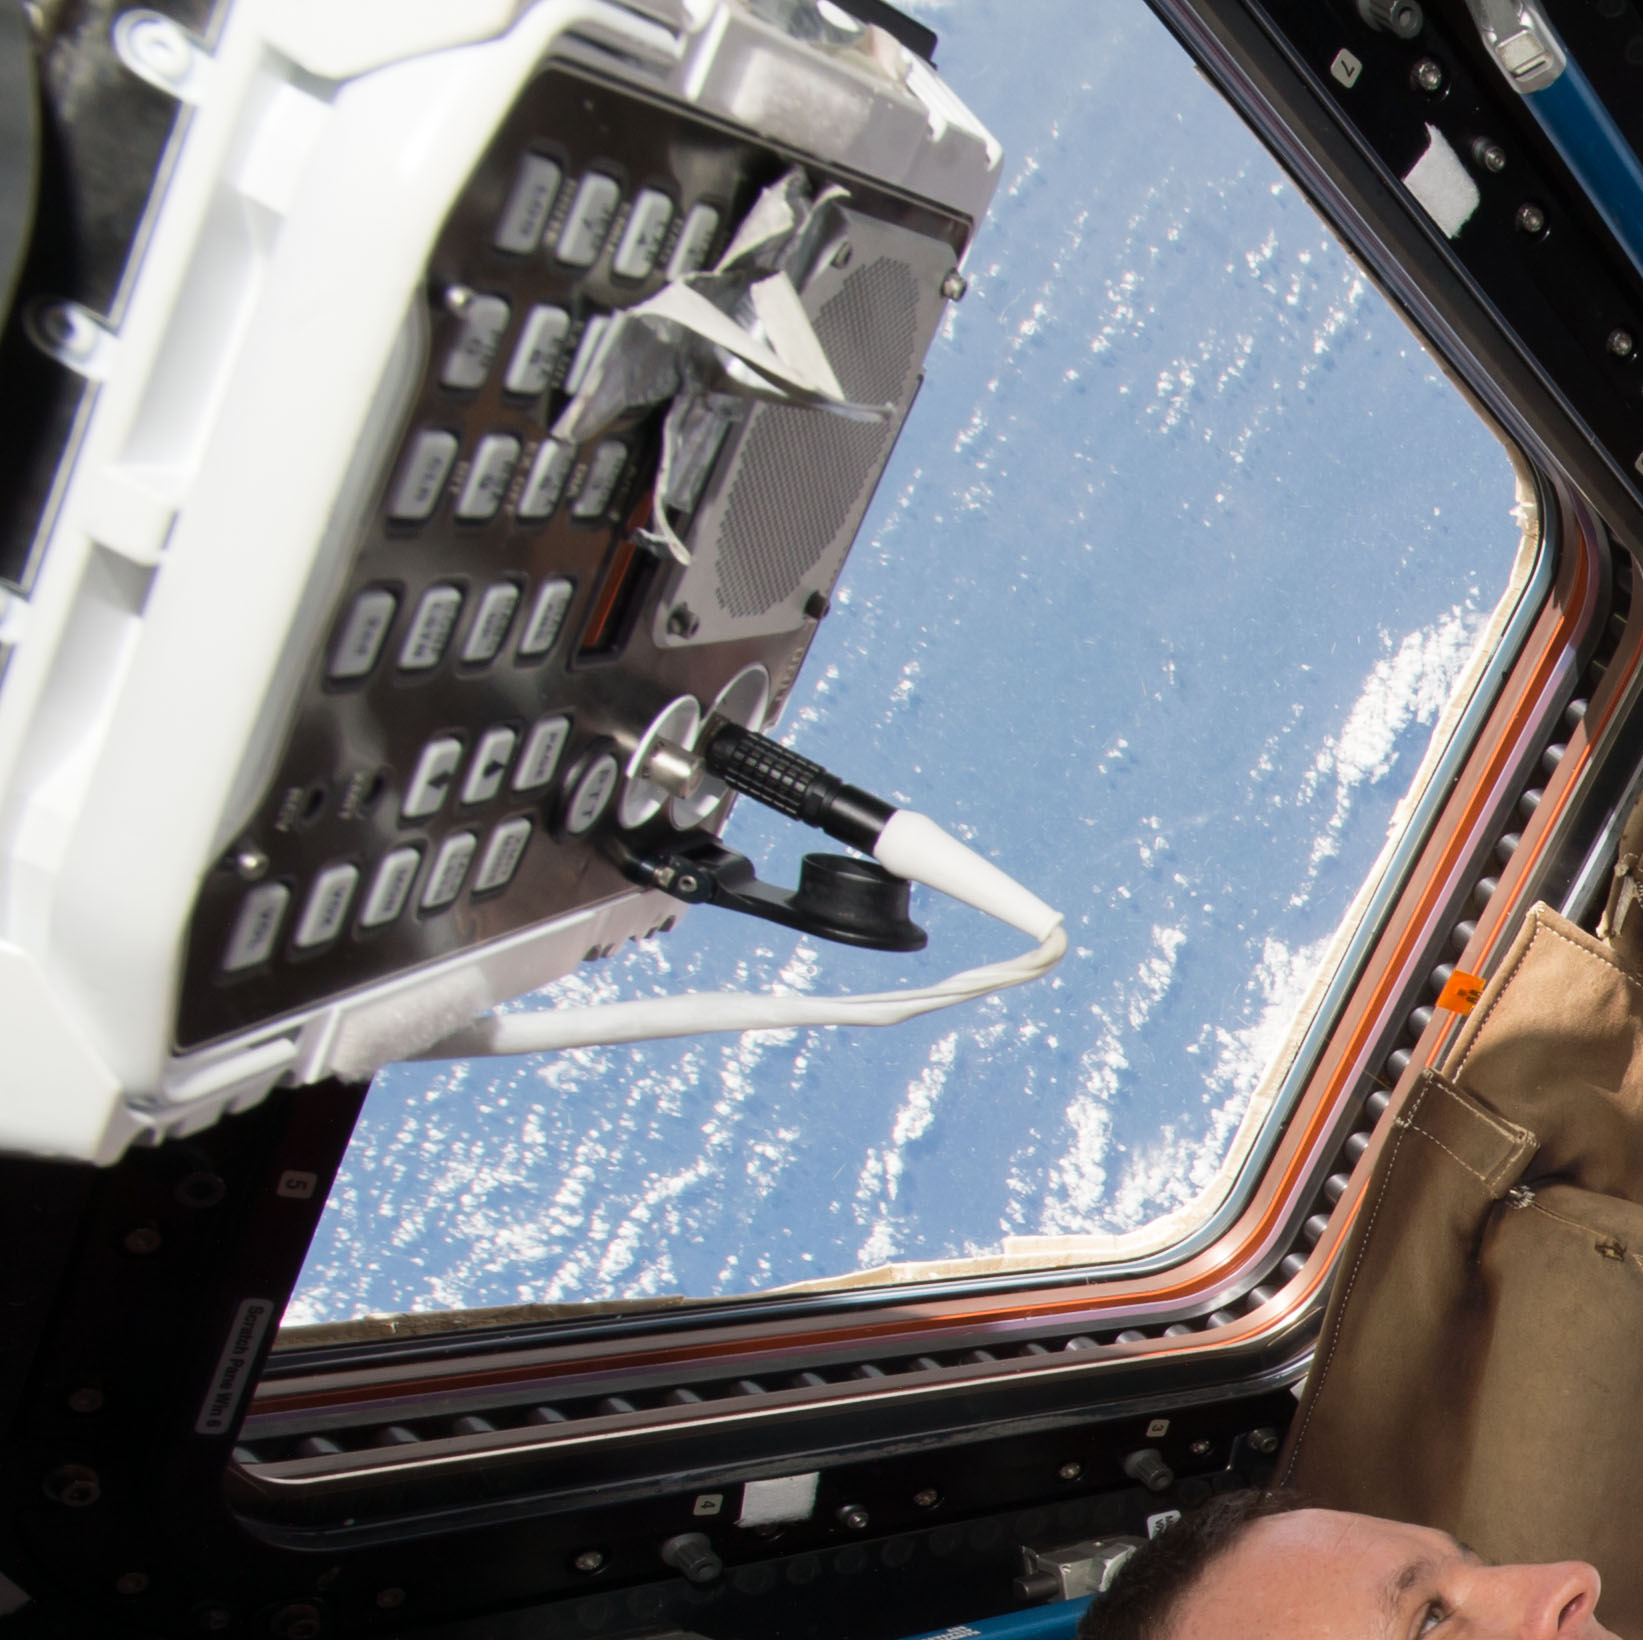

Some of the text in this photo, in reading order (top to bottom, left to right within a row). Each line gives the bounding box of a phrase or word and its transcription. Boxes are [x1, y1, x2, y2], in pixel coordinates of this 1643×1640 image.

[1337, 61, 1353, 76] 7
[578, 766, 610, 821] PTT
[283, 1177, 307, 1191] 5
[203, 1303, 265, 1430] Scratch Pane Win 6
[1151, 1423, 1165, 1432] 3
[700, 1498, 716, 1511] 4
